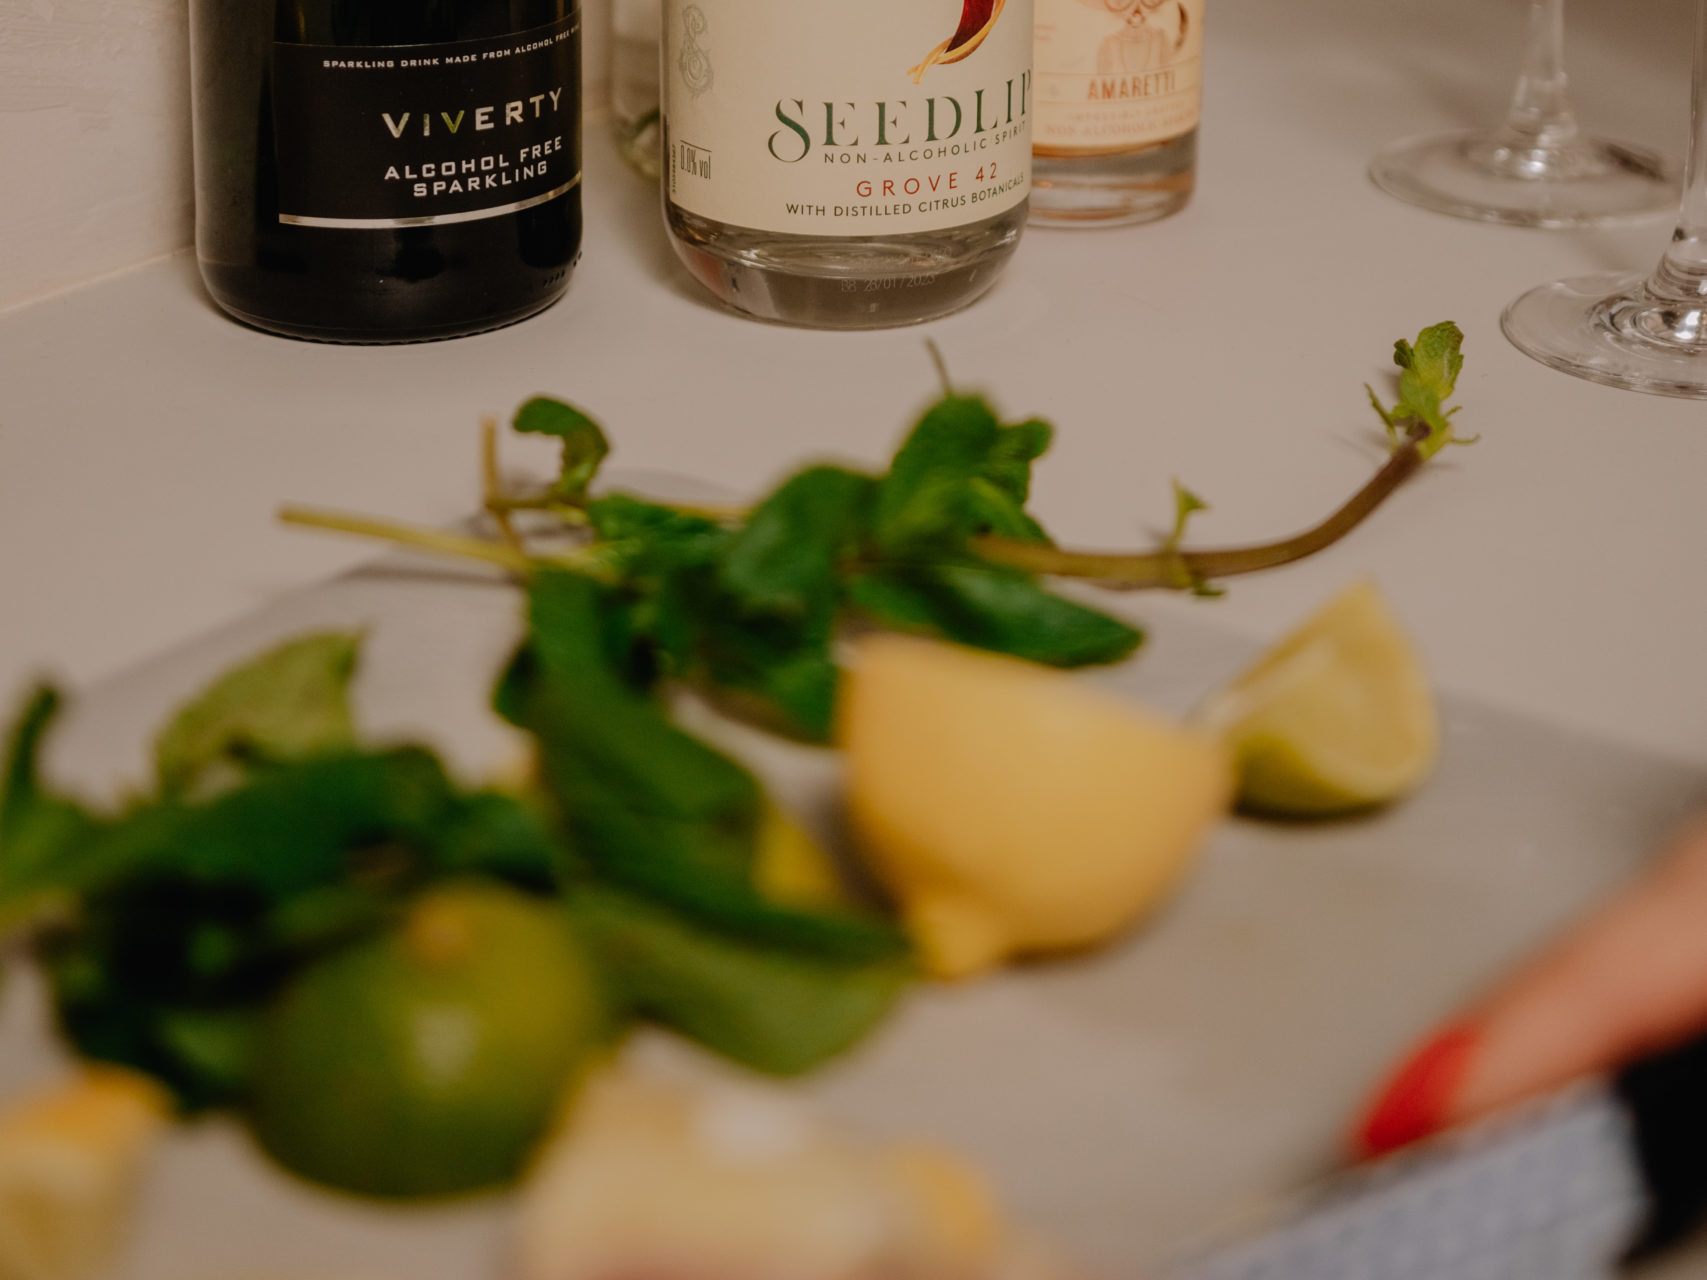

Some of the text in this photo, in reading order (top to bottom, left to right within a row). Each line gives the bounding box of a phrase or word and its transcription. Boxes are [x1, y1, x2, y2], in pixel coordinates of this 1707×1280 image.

[323, 30, 570, 68] SPARKLING DRINK MADE FROM ALCOHOL FREE
[1086, 68, 1175, 100] AMARETTI
[381, 87, 562, 139] VIVERTY
[384, 136, 563, 180] ALCOHOL FREE
[680, 144, 697, 175] 0.0%
[699, 154, 711, 180] vol
[824, 139, 988, 164] NON-ALCOHOLIC
[413, 160, 548, 197] SPARKLING
[786, 175, 1025, 217] WITH DISTILLED CITRUS BOTANICALS
[856, 162, 998, 198] GROVE 42
